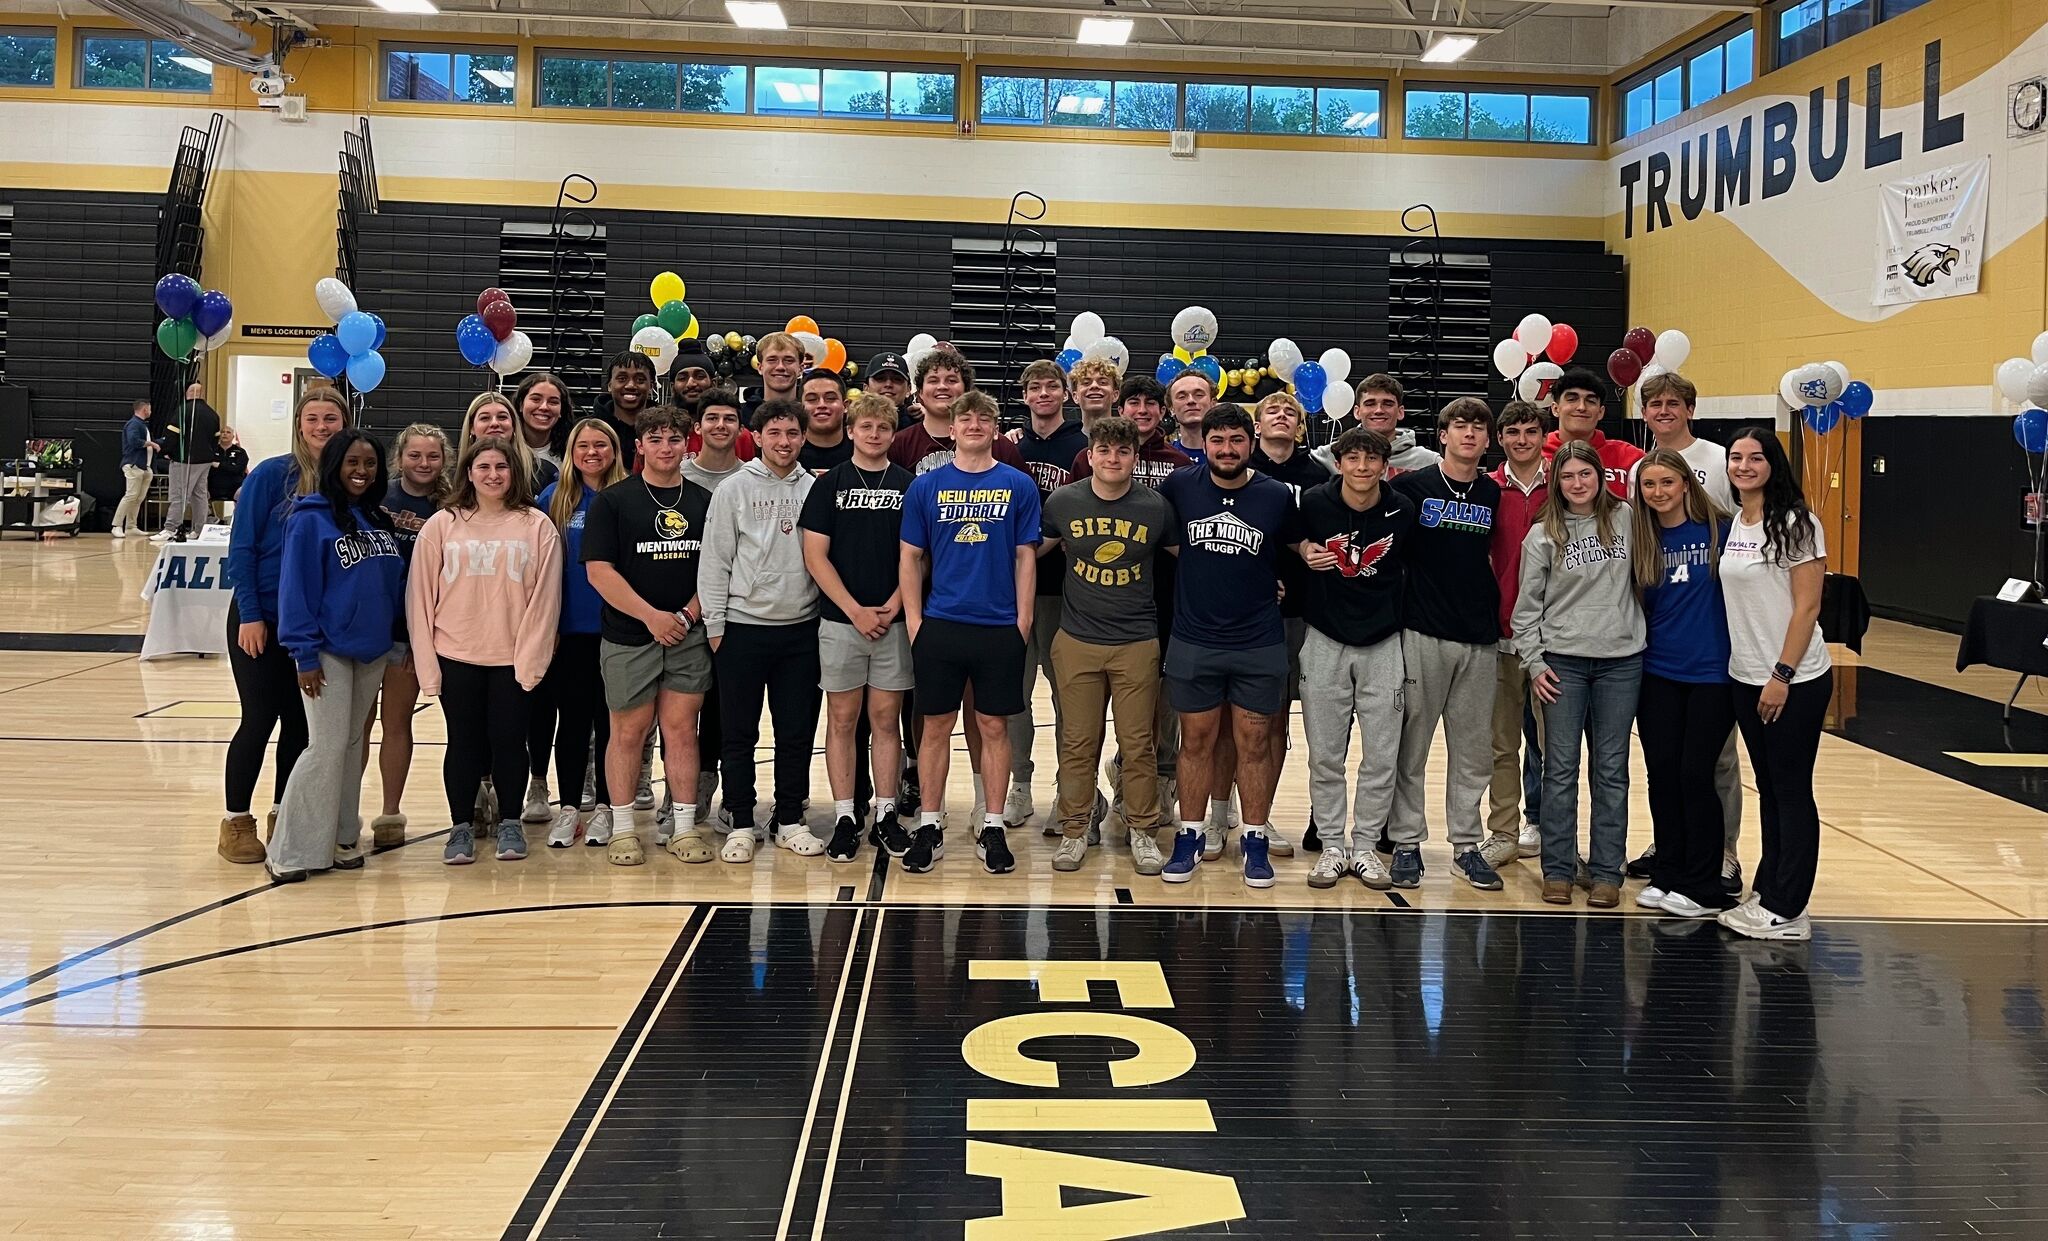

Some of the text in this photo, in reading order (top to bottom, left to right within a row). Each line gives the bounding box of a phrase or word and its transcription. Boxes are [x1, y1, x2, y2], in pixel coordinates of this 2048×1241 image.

[1620, 38, 1964, 240] TRUMBULL
[1904, 174, 1959, 219] parker.
[1913, 194, 1955, 209] RESTAURANTS
[1904, 219, 1921, 227] PROUD
[1906, 222, 1952, 237] TRUMBULL ATHLETICS
[250, 327, 273, 335] MEN'S
[845, 494, 904, 510] RUGBY
[937, 489, 1012, 503] NEW HAVEN
[940, 504, 1008, 519] FOOTBALL
[1420, 498, 1492, 528] SALVE
[1069, 517, 1148, 544] SIENA
[1189, 522, 1261, 551] THE MOUNT
[636, 540, 702, 554] WENTWORTH
[1204, 542, 1242, 555] RUGBY
[442, 539, 530, 585] OWU
[653, 552, 690, 561] BASEBALL
[1073, 557, 1141, 586] RUGBY
[1670, 564, 1690, 584] A
